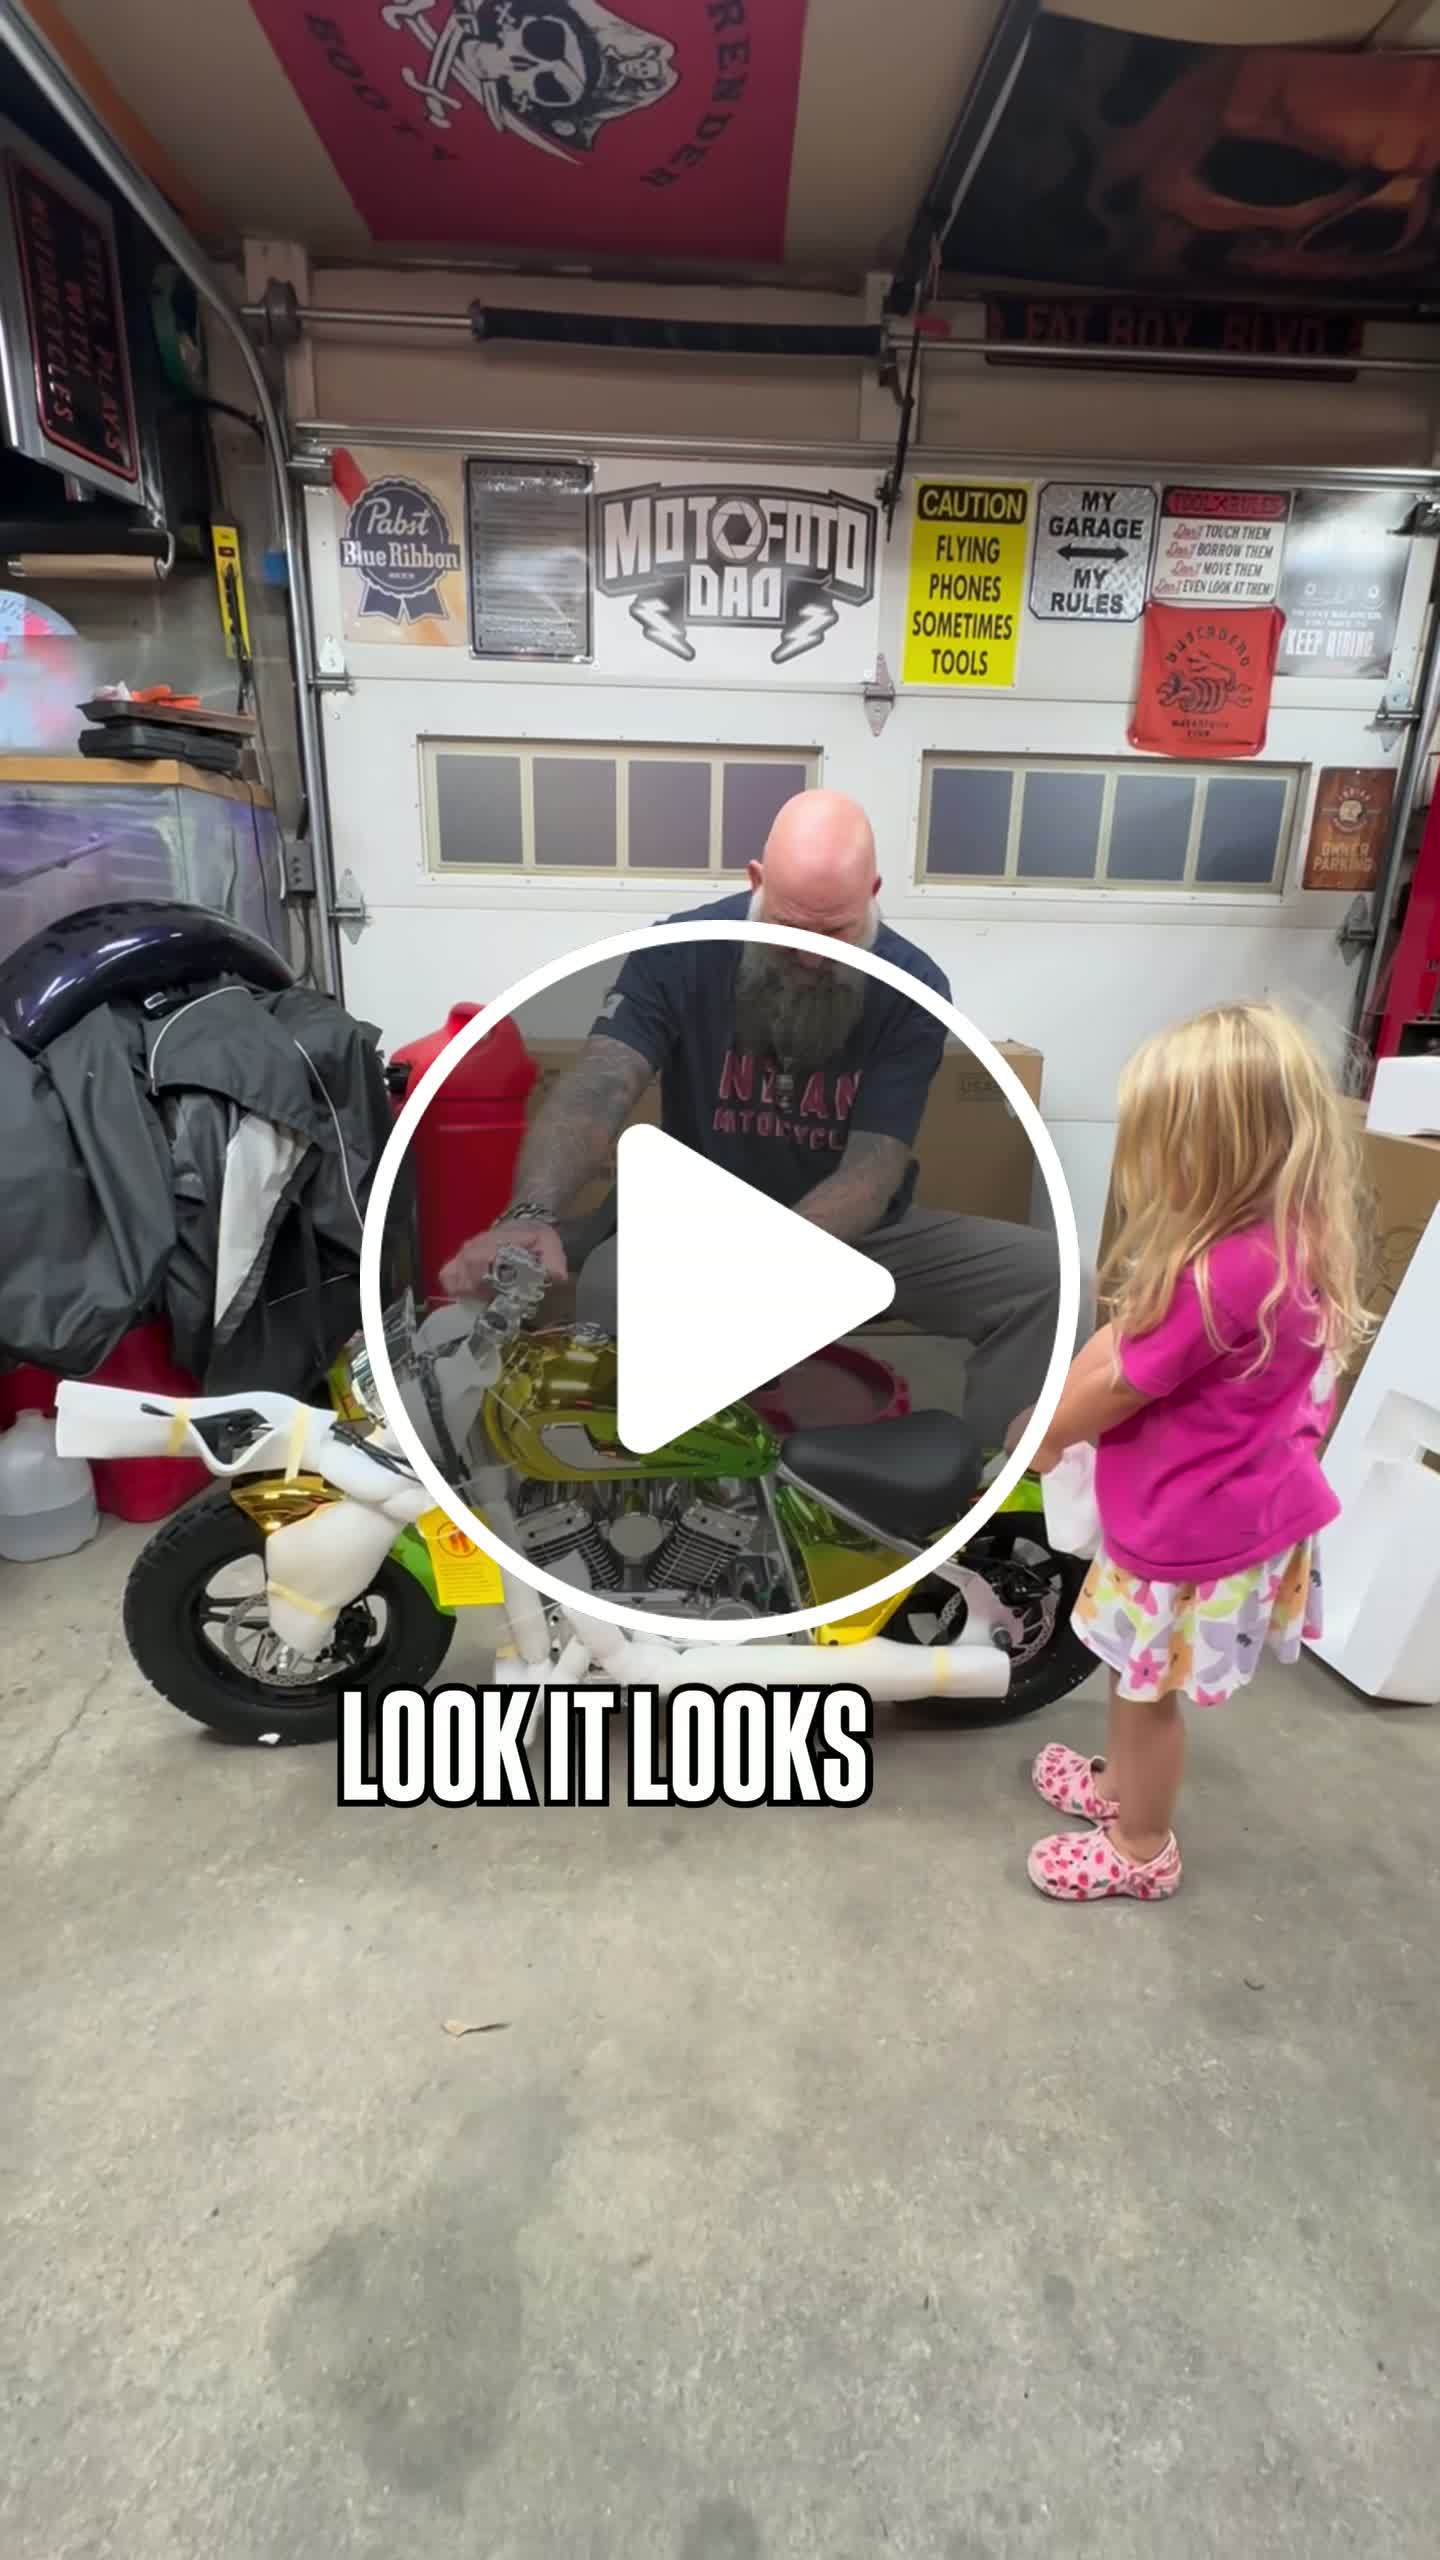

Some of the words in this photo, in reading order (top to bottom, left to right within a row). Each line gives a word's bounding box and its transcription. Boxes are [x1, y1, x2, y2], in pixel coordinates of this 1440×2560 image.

[921, 488, 1023, 519] CAUTION
[1081, 490, 1117, 513] MY
[363, 497, 433, 537] Pabst
[1049, 516, 1144, 540] GARAGE
[1206, 525, 1240, 539] TOUCH
[1241, 526, 1272, 540] THEM
[342, 540, 387, 567] Blue
[388, 541, 459, 569] Ribbon
[936, 534, 1000, 564] FLYING
[1196, 543, 1242, 557] BORROW
[1244, 545, 1274, 559] THEM
[1073, 568, 1109, 590] MY
[1203, 561, 1232, 576] MOVE
[1233, 563, 1264, 577] THEM
[689, 564, 782, 618] DAD
[929, 573, 1002, 602] PHONES
[1182, 580, 1207, 593] EVEN
[1207, 580, 1232, 594] LOOK
[1233, 581, 1245, 595] AT
[1050, 592, 1124, 614] RULES
[912, 611, 1013, 640] SOMETIMES
[1285, 629, 1323, 656] KEEP
[931, 649, 988, 676] TOOLS
[1312, 856, 1374, 873] PARKING
